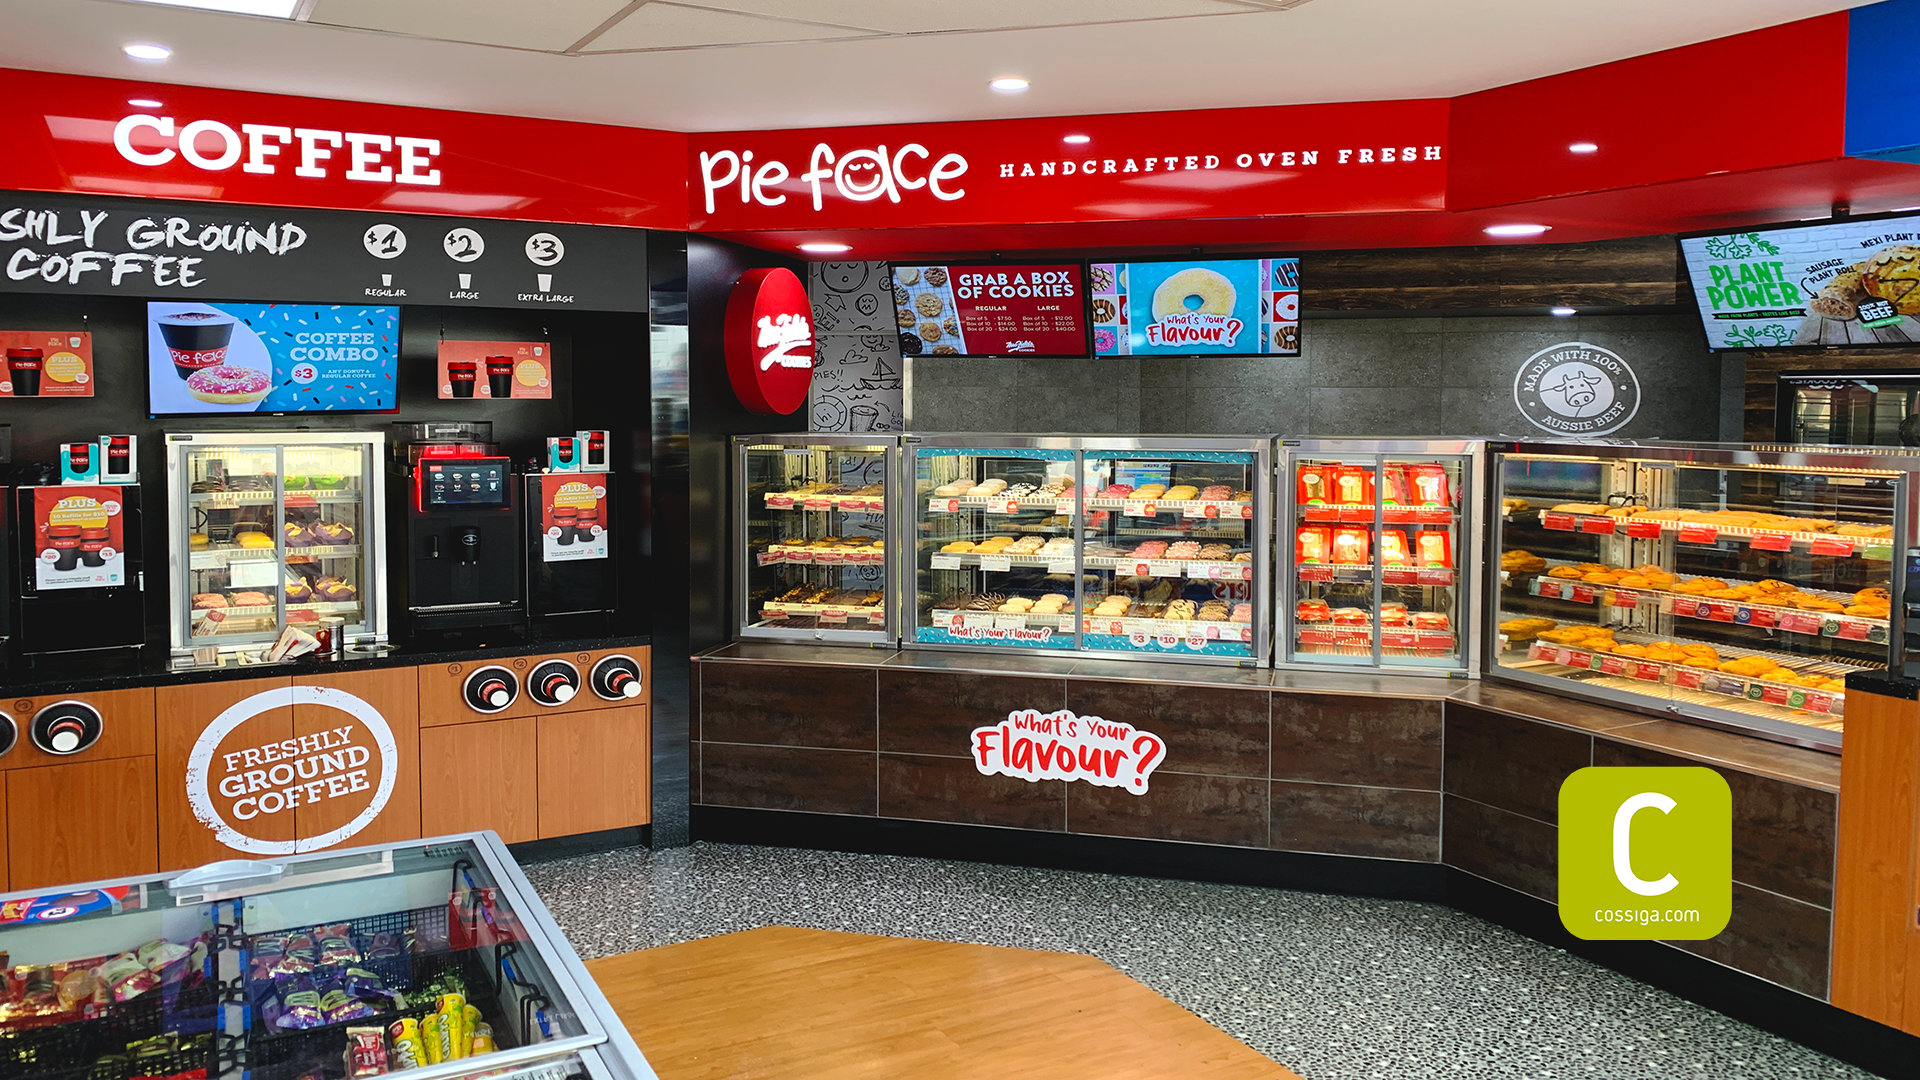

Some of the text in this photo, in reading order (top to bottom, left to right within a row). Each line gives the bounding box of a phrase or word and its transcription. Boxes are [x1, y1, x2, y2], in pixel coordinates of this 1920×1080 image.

[113, 114, 441, 186] COFFEE
[1000, 146, 1442, 178] HANDCRAFTED OVEN FRESH
[700, 142, 968, 214] Pie face
[127, 216, 308, 256] GROUND
[367, 229, 398, 254] $1
[447, 233, 478, 258] $2
[1860, 237, 1883, 248] MEXI
[1884, 233, 1914, 243] PLANT
[532, 238, 558, 261] $3
[6, 247, 207, 288] COFFEE
[1708, 261, 1784, 287] PLANT
[1805, 258, 1844, 274] SAUSAGE
[1809, 265, 1857, 284] PLANT ROLL
[959, 271, 1070, 286] GRAB A BOX
[365, 288, 407, 297] REGULAR
[449, 291, 480, 300] LARGE
[517, 293, 575, 303] EXTRA LARGE
[957, 284, 1075, 299] OF COOKIES
[1705, 281, 1804, 310] POWER
[1166, 313, 1225, 325] What's Your
[1860, 306, 1893, 321] BEEF
[295, 332, 375, 344] COFFEE
[1148, 319, 1241, 343] Flavour?
[290, 347, 379, 361] COMBO
[294, 368, 313, 379] $3
[1524, 350, 1623, 392] MADE WITH 100%
[1541, 401, 1626, 431] AUSSIE BEEF
[560, 484, 588, 493] PLUS
[58, 498, 96, 509] PLUS
[949, 627, 1050, 642] What's Your Flavour?
[1133, 635, 1145, 643] $3
[1158, 636, 1176, 644] $10
[1014, 713, 1131, 741] What's Your
[223, 725, 353, 773] FRESHLY
[975, 725, 1161, 787] Flavour?
[218, 745, 370, 798] GROUND
[232, 769, 370, 821] COFFEE
